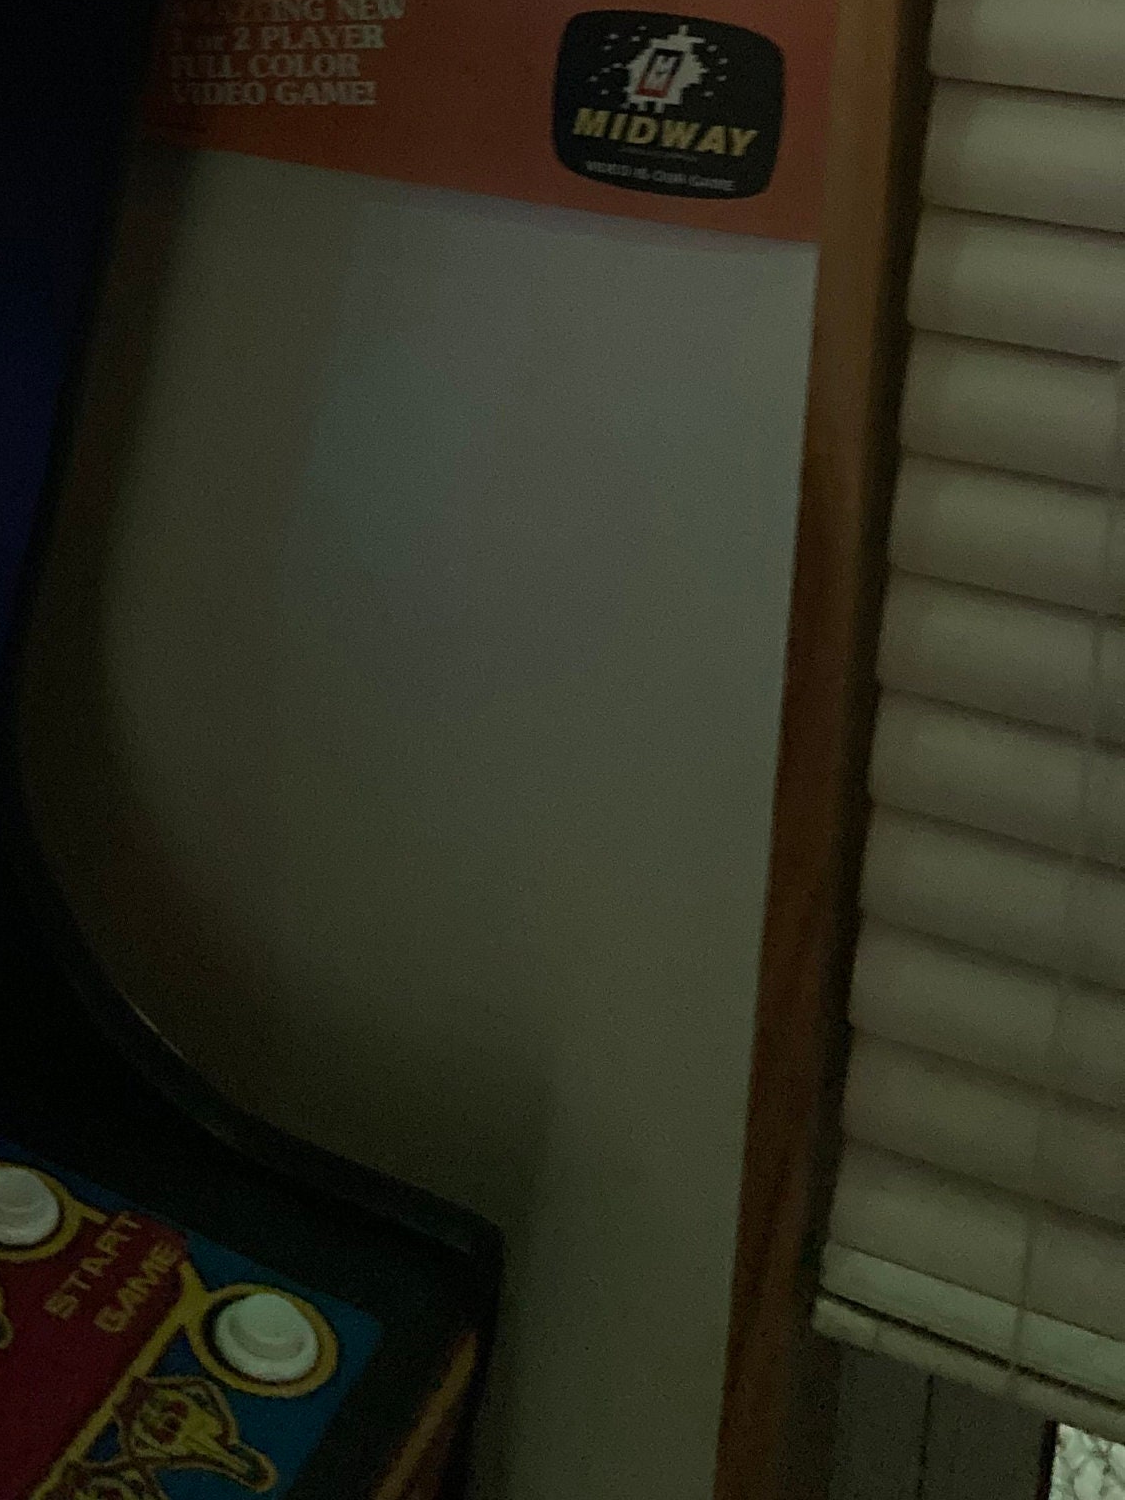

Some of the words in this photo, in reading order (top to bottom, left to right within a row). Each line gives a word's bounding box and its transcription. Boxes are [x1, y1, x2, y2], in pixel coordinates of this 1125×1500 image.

[232, 26, 253, 51] 2
[260, 24, 387, 50] PLAYER
[248, 54, 362, 79] COLOR
[274, 81, 377, 106] GAME!
[572, 106, 761, 157] MIDWAY
[43, 1211, 143, 1321] START
[92, 1240, 182, 1334] GAME
